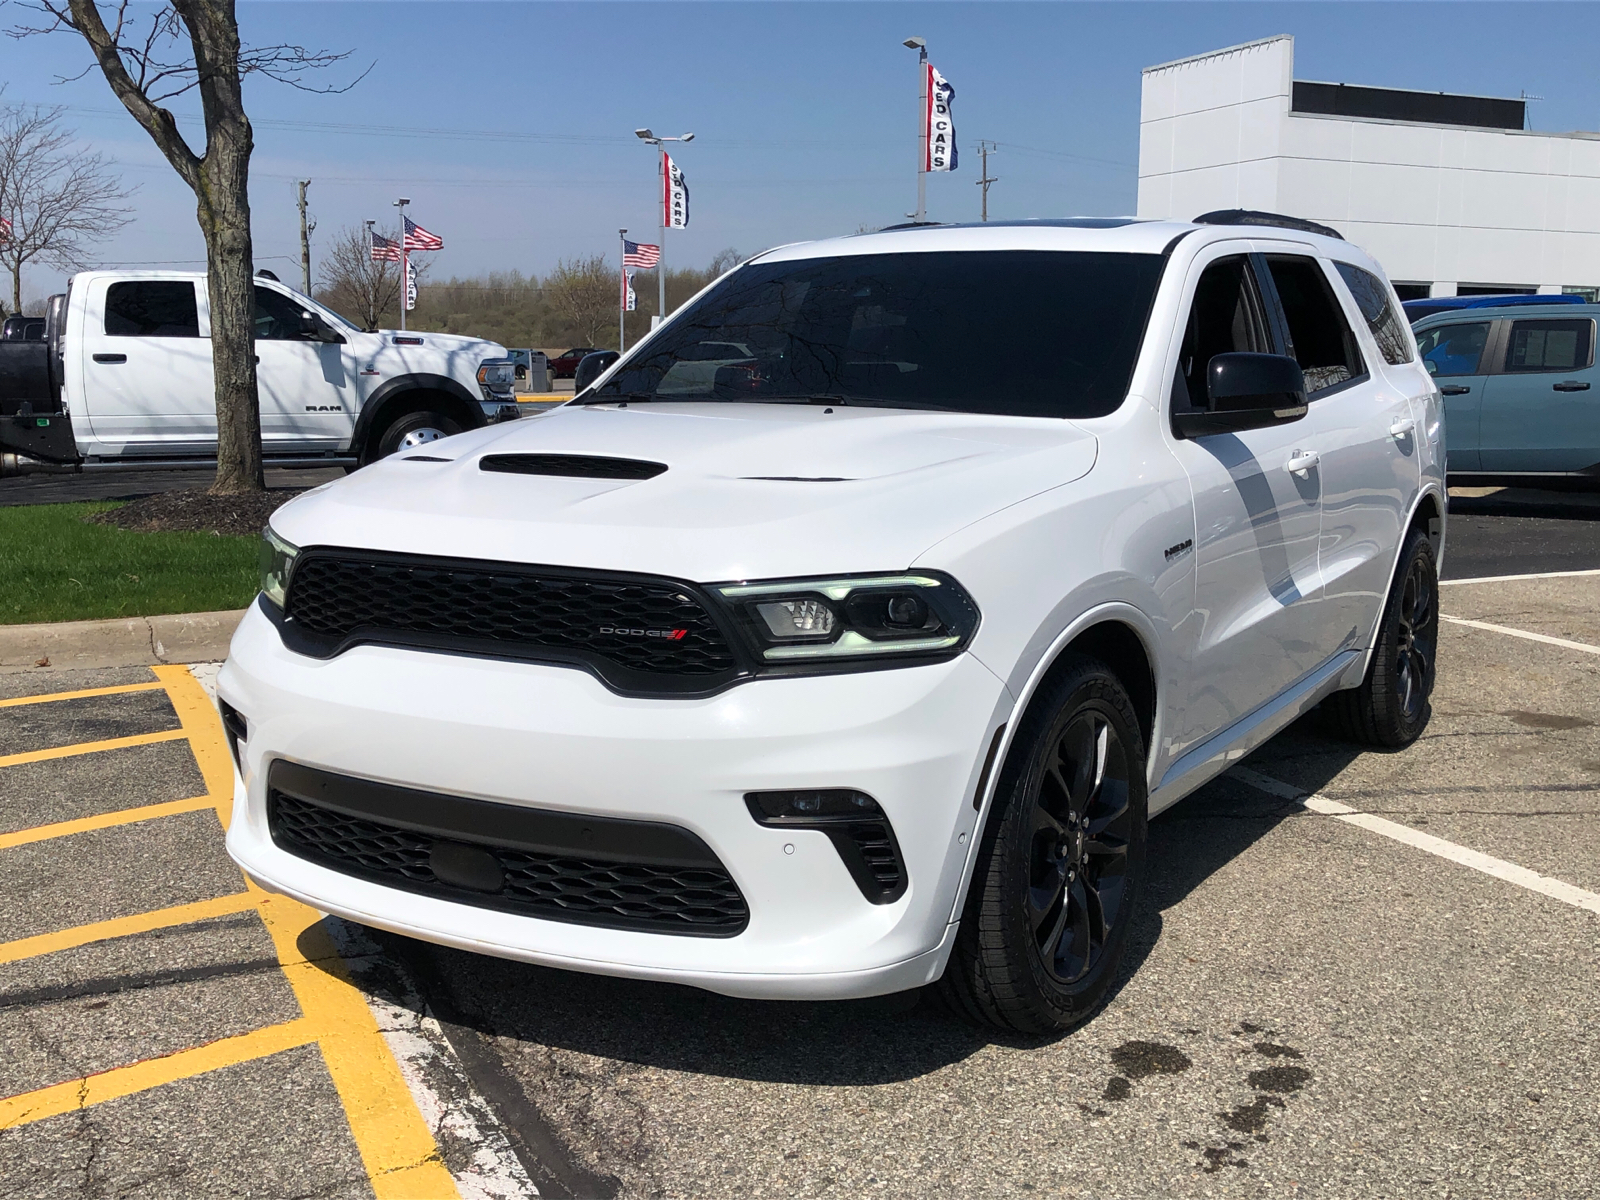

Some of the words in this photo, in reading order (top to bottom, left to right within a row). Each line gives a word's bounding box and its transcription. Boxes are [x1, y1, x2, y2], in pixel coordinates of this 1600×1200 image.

[934, 121, 947, 167] CARS
[674, 192, 682, 226] CARS
[600, 627, 676, 639] DODGE
